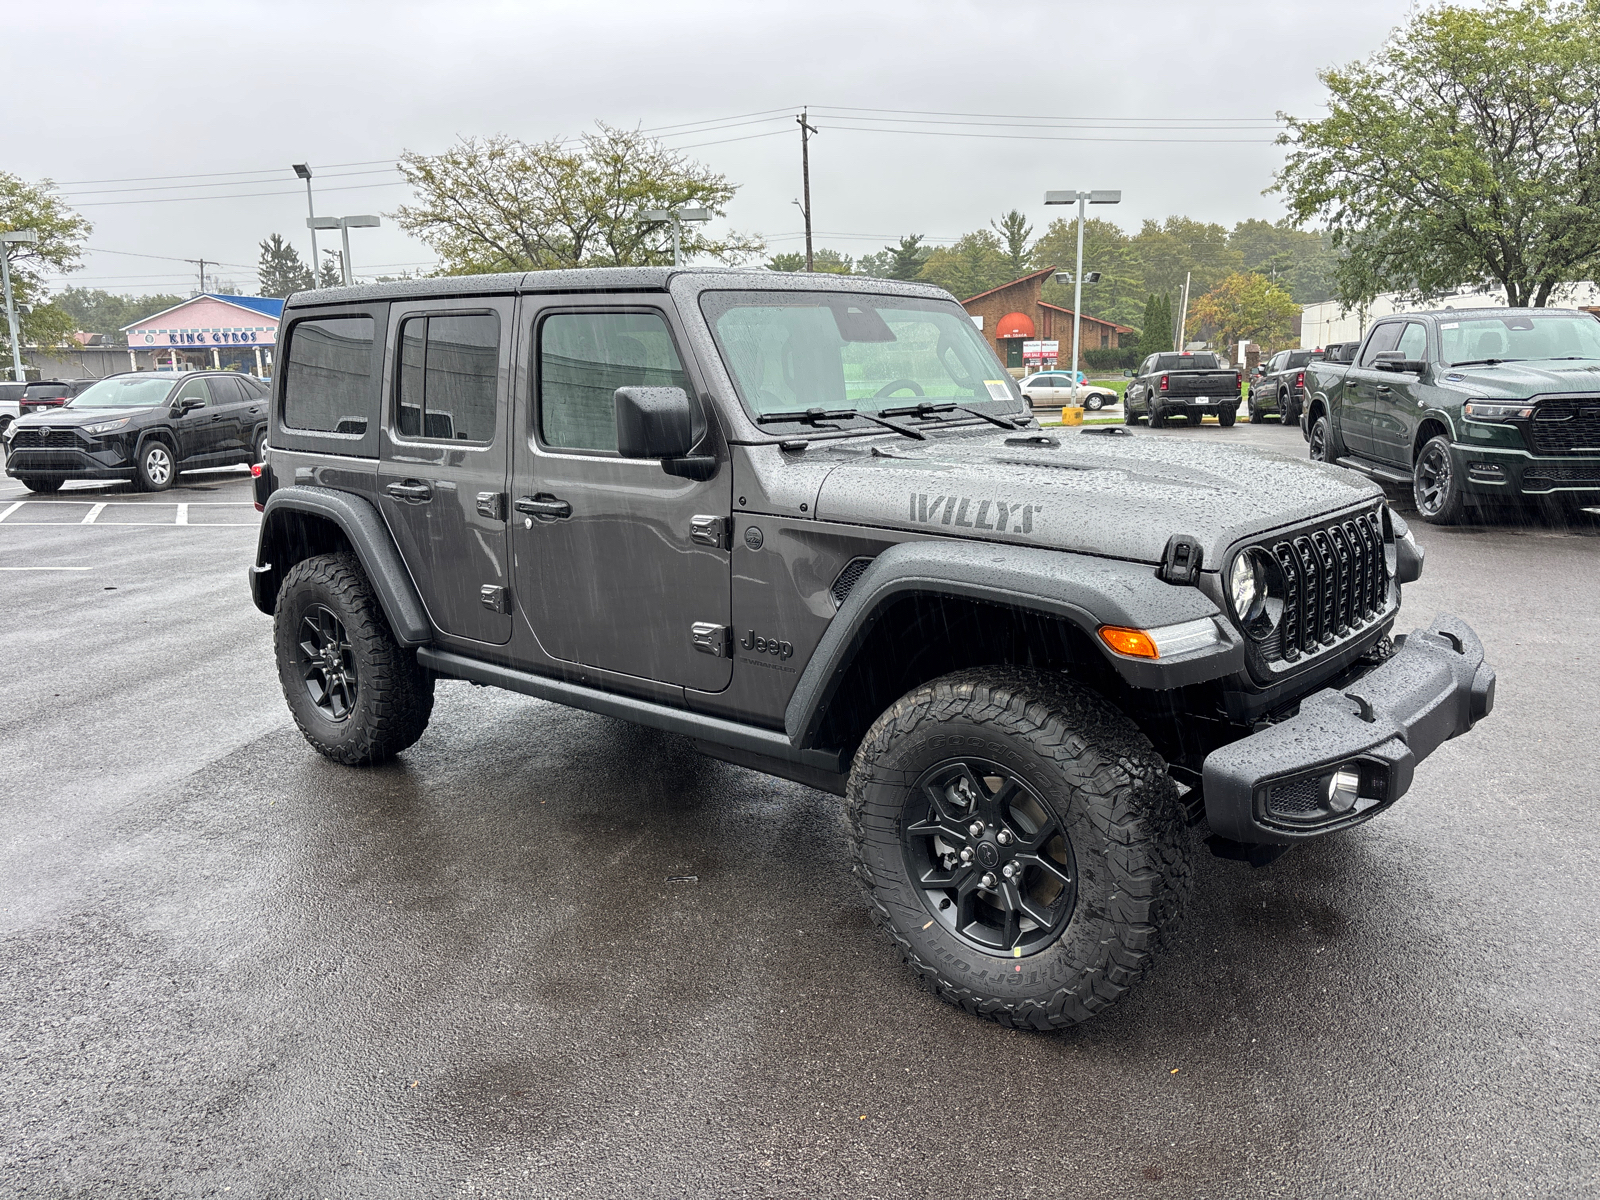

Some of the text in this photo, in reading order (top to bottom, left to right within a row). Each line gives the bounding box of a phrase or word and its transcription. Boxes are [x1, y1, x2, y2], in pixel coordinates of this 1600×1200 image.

[169, 332, 257, 344] KING GYROS
[909, 492, 1043, 534] WILLYS
[740, 629, 794, 661] Jeep
[747, 658, 797, 674] WRANGLER
